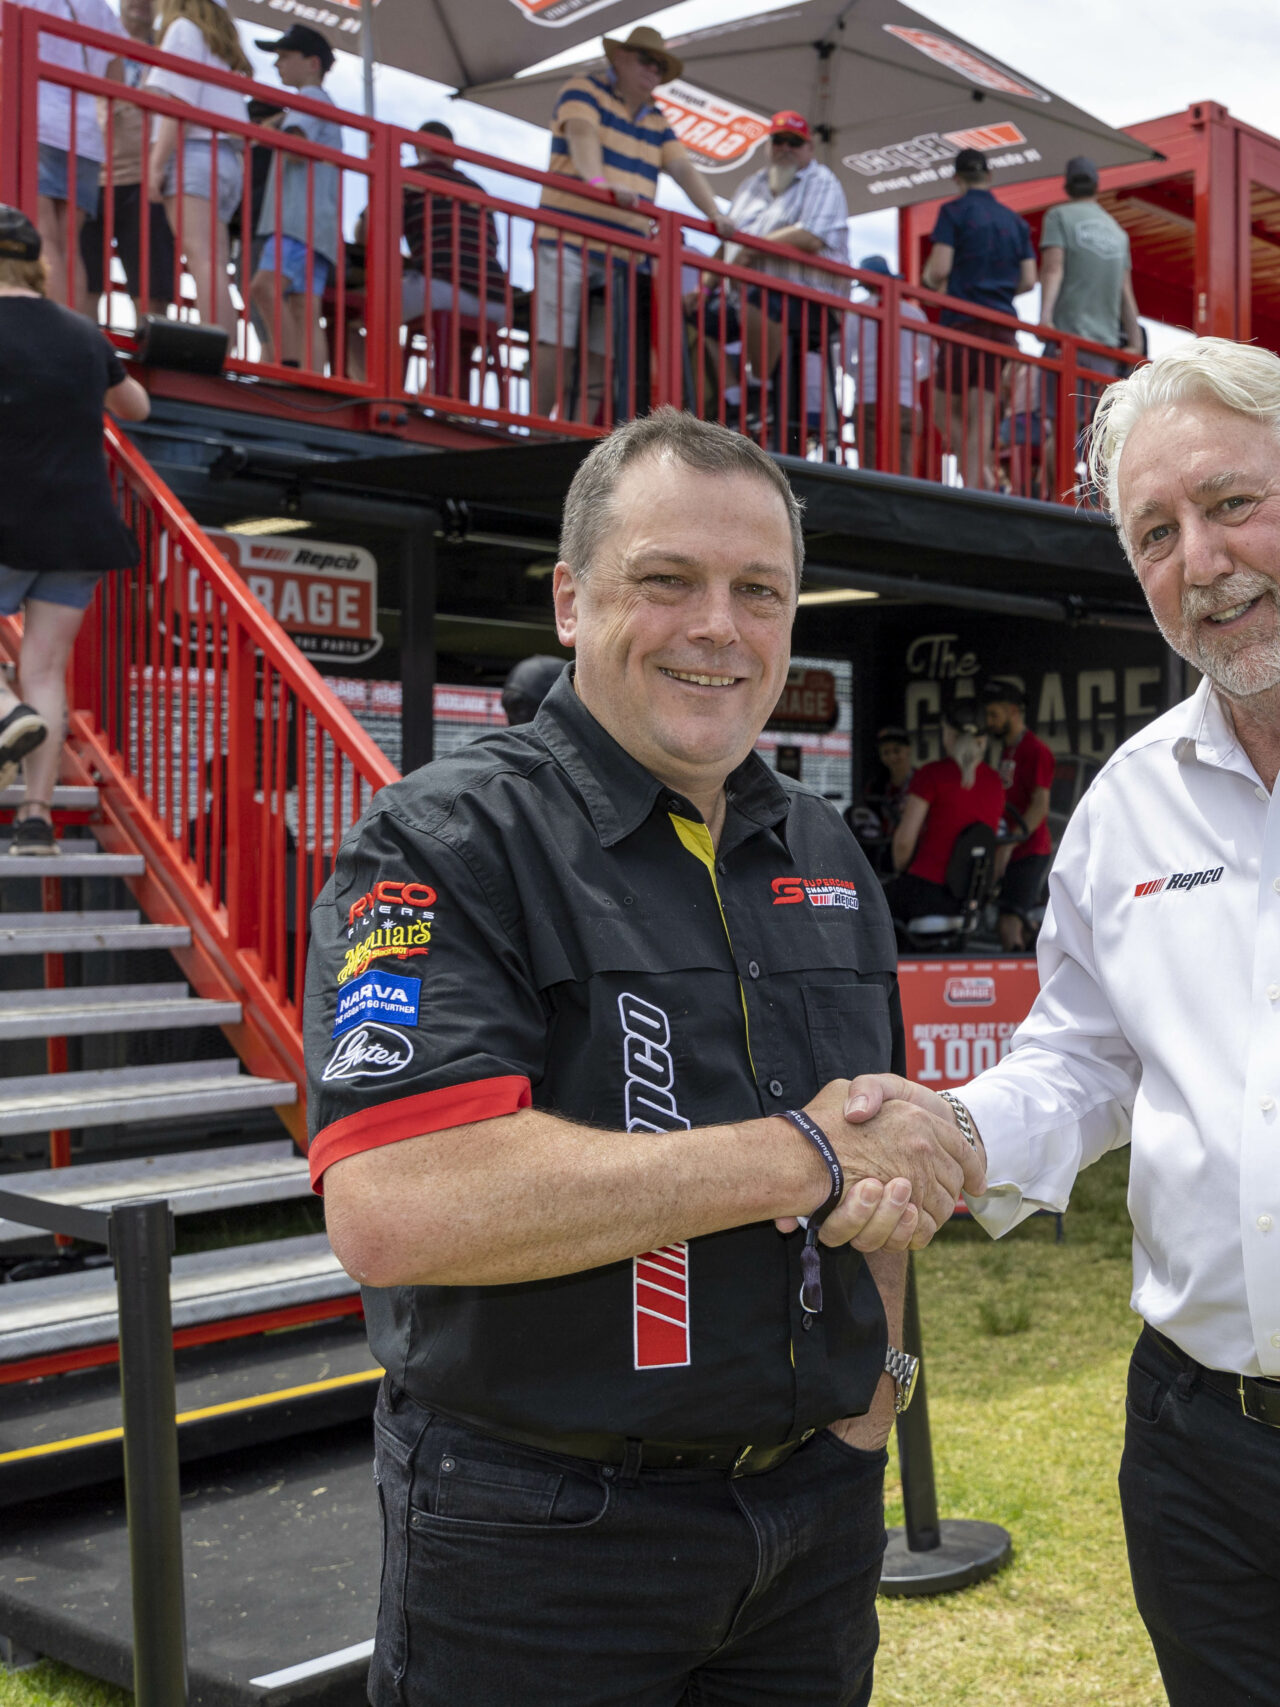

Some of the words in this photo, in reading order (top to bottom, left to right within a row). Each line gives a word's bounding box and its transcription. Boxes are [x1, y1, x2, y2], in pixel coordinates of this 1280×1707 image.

[294, 548, 360, 571] Repco
[906, 633, 982, 679] The
[802, 878, 856, 890] SUPERCARS
[804, 885, 857, 897] CHAMPIONSHIP
[1165, 866, 1225, 891] Repco
[348, 880, 438, 928] RYCO
[832, 892, 860, 911] Repco
[337, 919, 432, 985] Meguiar's
[339, 984, 409, 1013] NARVA
[366, 999, 379, 1009] GO
[380, 1001, 416, 1014] FURTHER
[912, 1023, 959, 1041] REPCO
[961, 1023, 996, 1040] SLOT
[996, 1022, 1021, 1039] CA
[337, 1030, 405, 1067] Gates
[810, 1129, 833, 1162] Lounge
